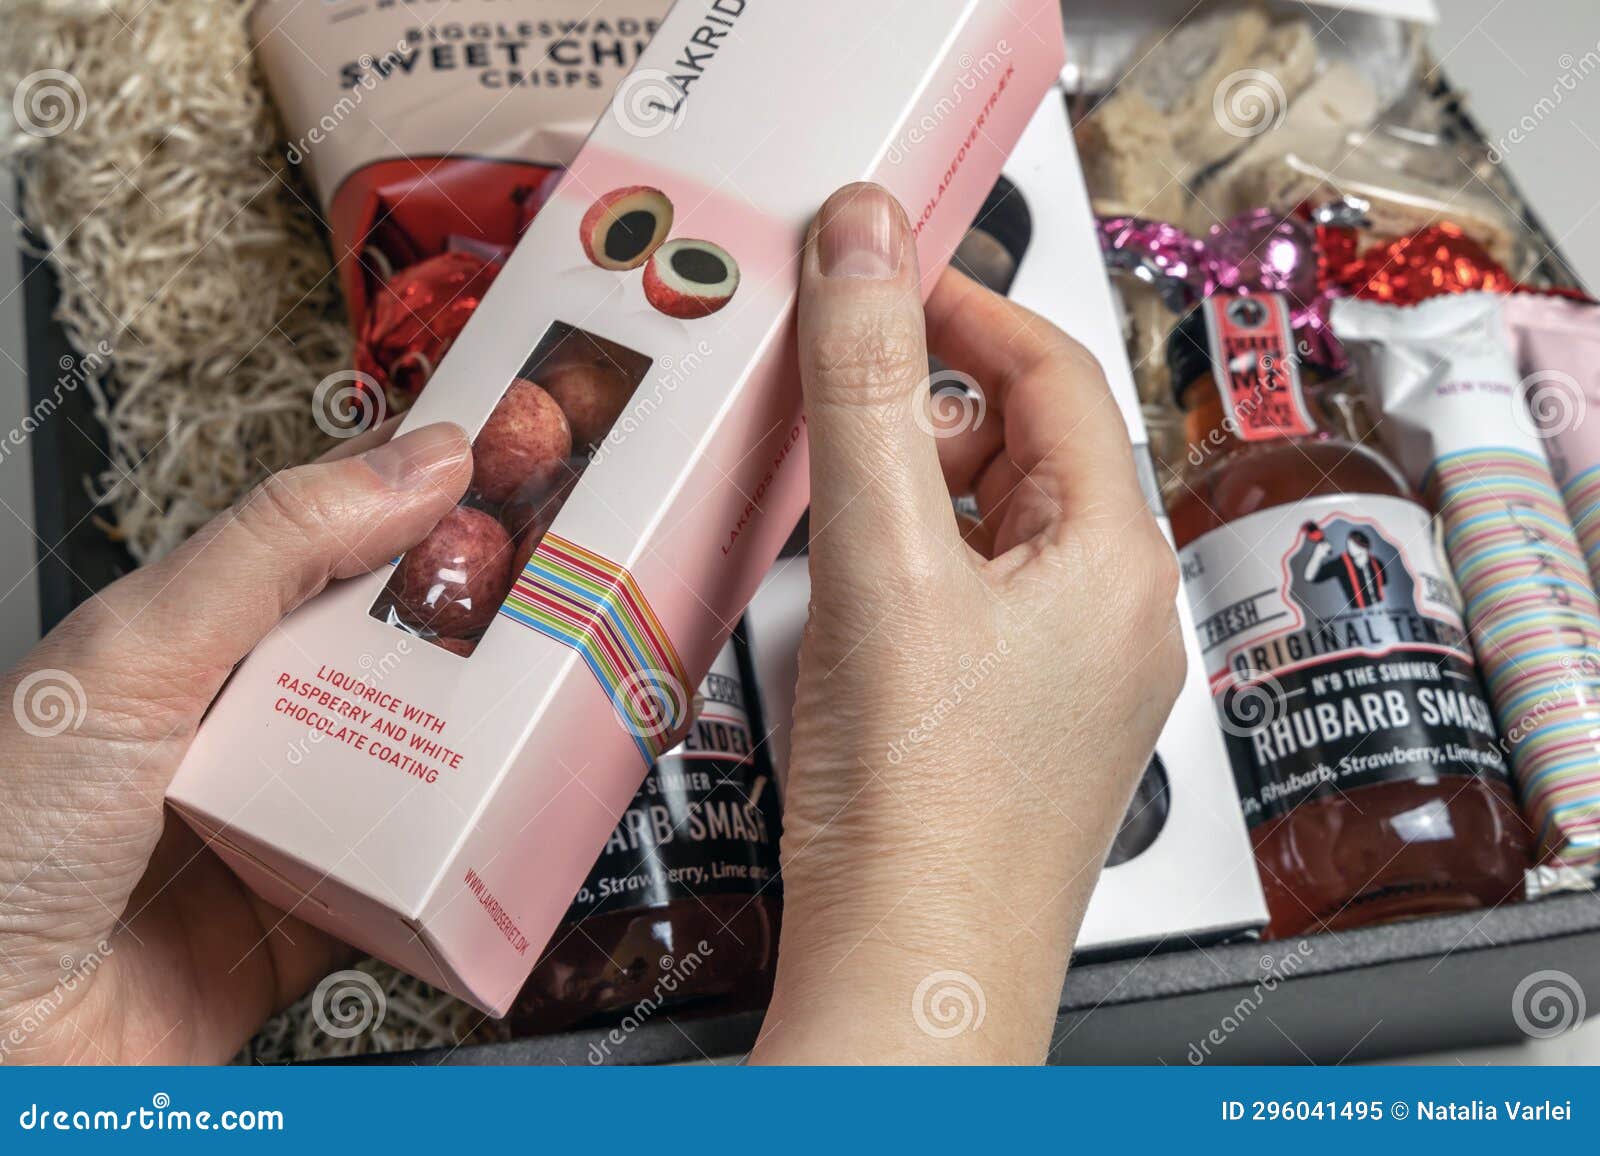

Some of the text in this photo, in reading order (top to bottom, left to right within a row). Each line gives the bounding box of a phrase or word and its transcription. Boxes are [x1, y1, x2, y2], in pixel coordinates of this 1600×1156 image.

[338, 40, 528, 91] SWEET
[479, 69, 603, 89] CRISPS
[1206, 599, 1260, 643] FRESH
[1234, 617, 1383, 681] ORIGINAL
[1344, 667, 1377, 687] THE
[1377, 661, 1442, 682] SUMMER
[276, 672, 464, 769] RASPBERRY AND WHITE
[316, 664, 447, 735] LIQUORICE WITH
[1250, 688, 1411, 766] RHUBARB
[274, 697, 440, 784] CHOCOLATE COATING
[647, 772, 712, 795] SUMMER
[1260, 762, 1338, 805] Rhubarb,
[1340, 746, 1446, 777] Strawberry,
[598, 865, 709, 898] Strawberry,
[711, 860, 747, 880] Lime
